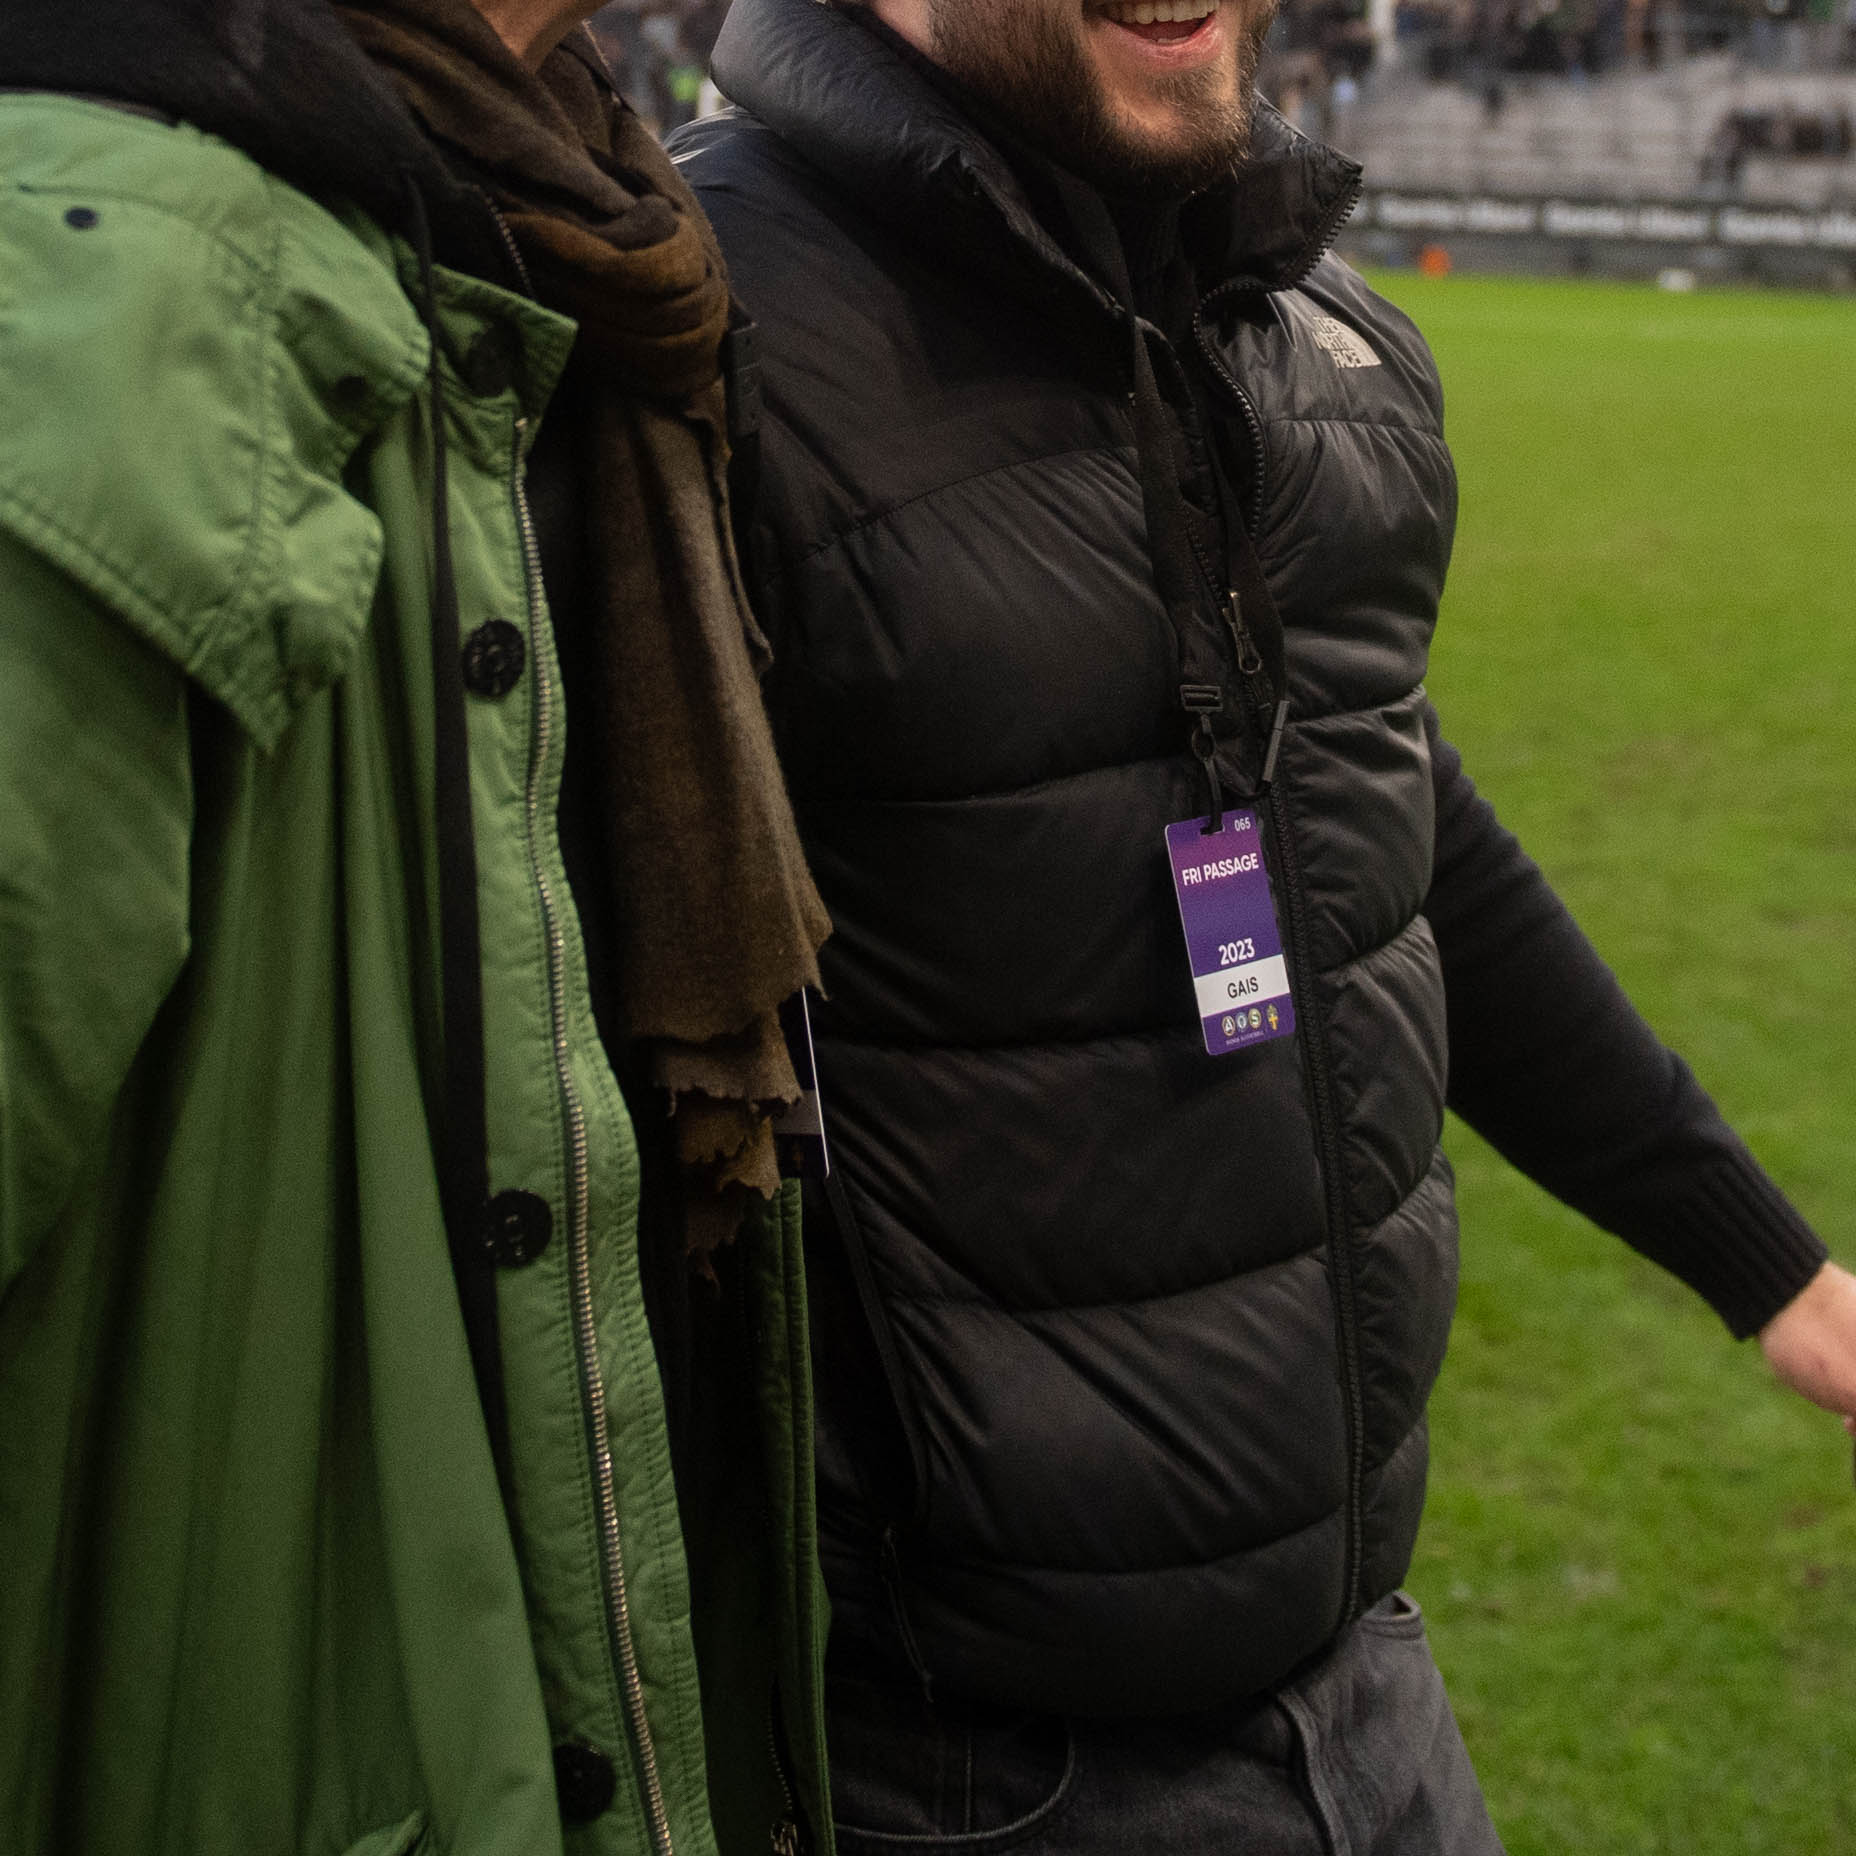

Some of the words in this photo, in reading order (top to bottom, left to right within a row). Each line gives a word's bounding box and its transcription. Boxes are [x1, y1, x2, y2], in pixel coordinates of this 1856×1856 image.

[1234, 816, 1251, 832] 065
[1182, 866, 1202, 886] FRI
[1203, 853, 1259, 881] PASSAGE
[1218, 938, 1256, 966] 2023
[1227, 976, 1259, 999] GAIS
